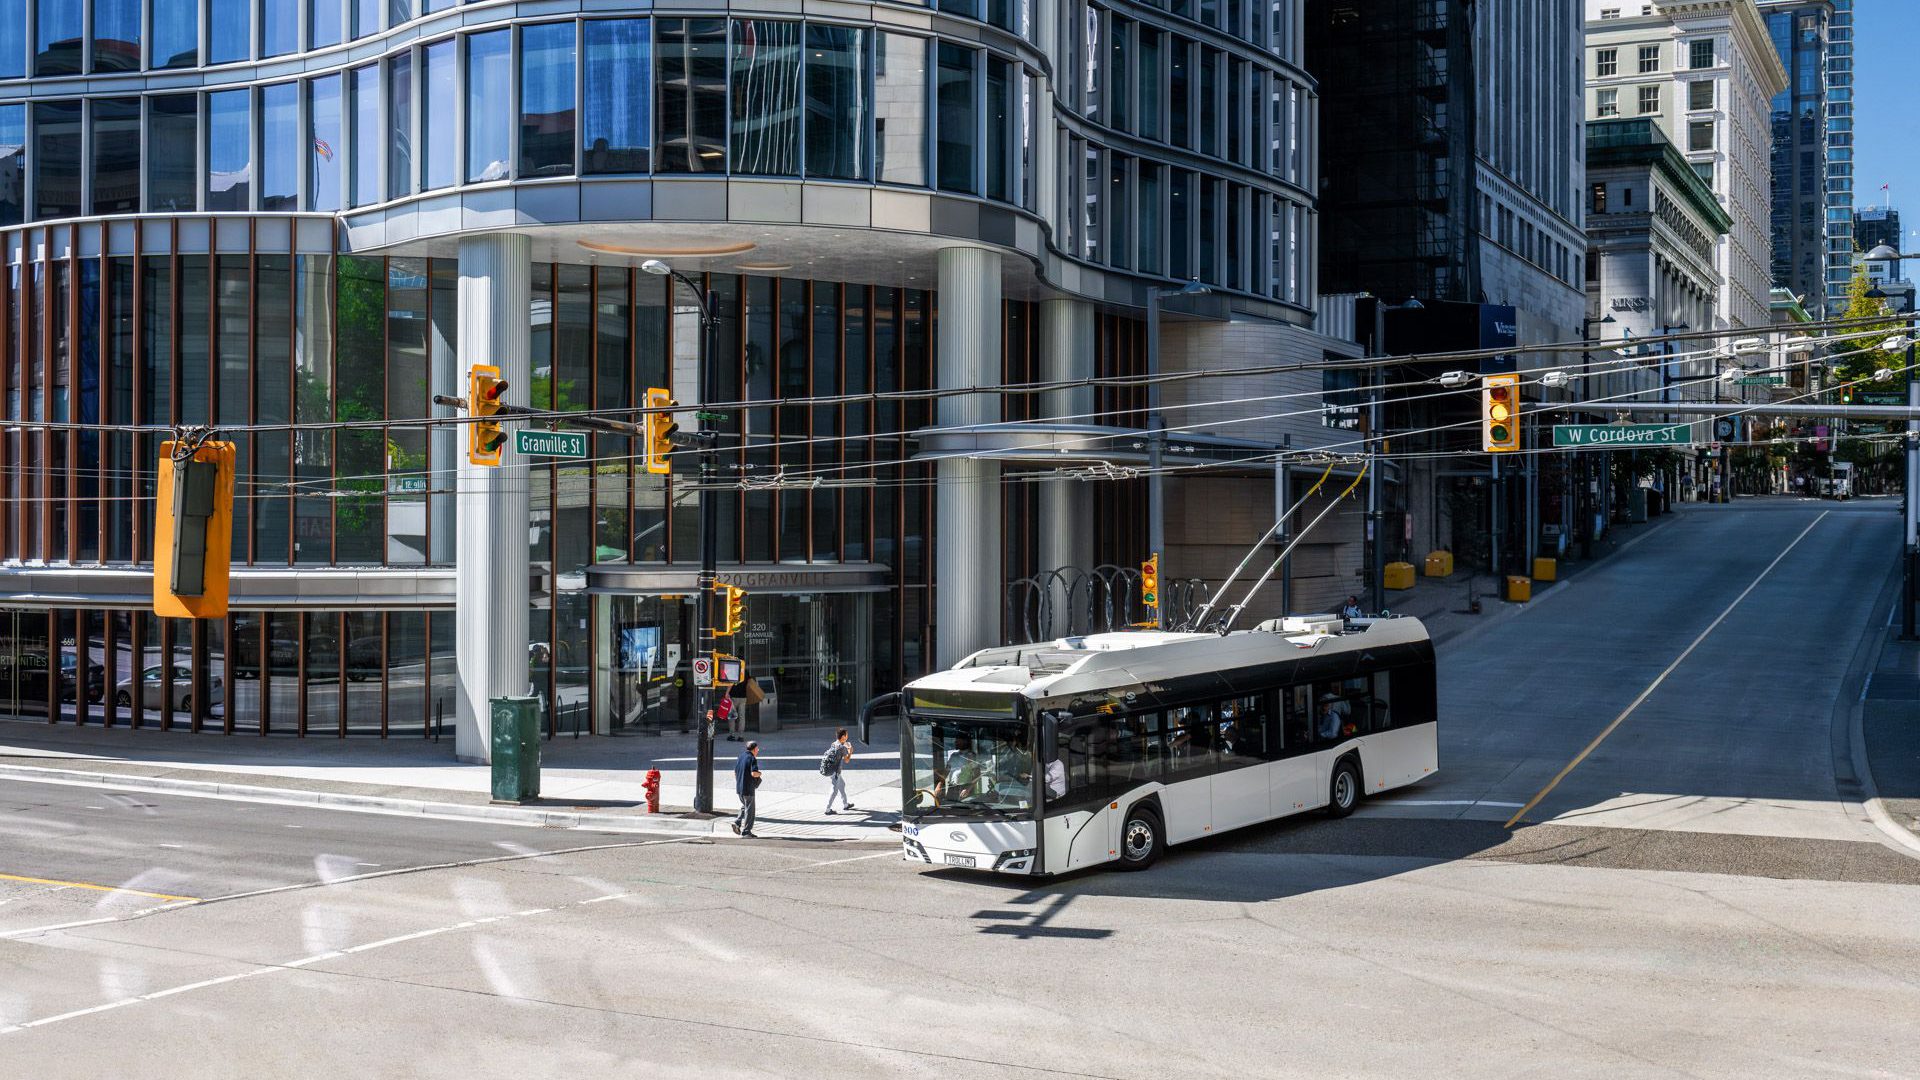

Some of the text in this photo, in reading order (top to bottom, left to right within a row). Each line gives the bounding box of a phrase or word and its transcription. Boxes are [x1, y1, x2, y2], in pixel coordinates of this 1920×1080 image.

[1610, 296, 1646, 308] BIRKS
[1568, 427, 1676, 442] W Cordova St
[521, 435, 580, 454] Granville St
[747, 572, 830, 586] GRANVILLE
[752, 623, 766, 631] 320
[63, 638, 75, 646] 660
[0, 655, 47, 667] RTNITIES
